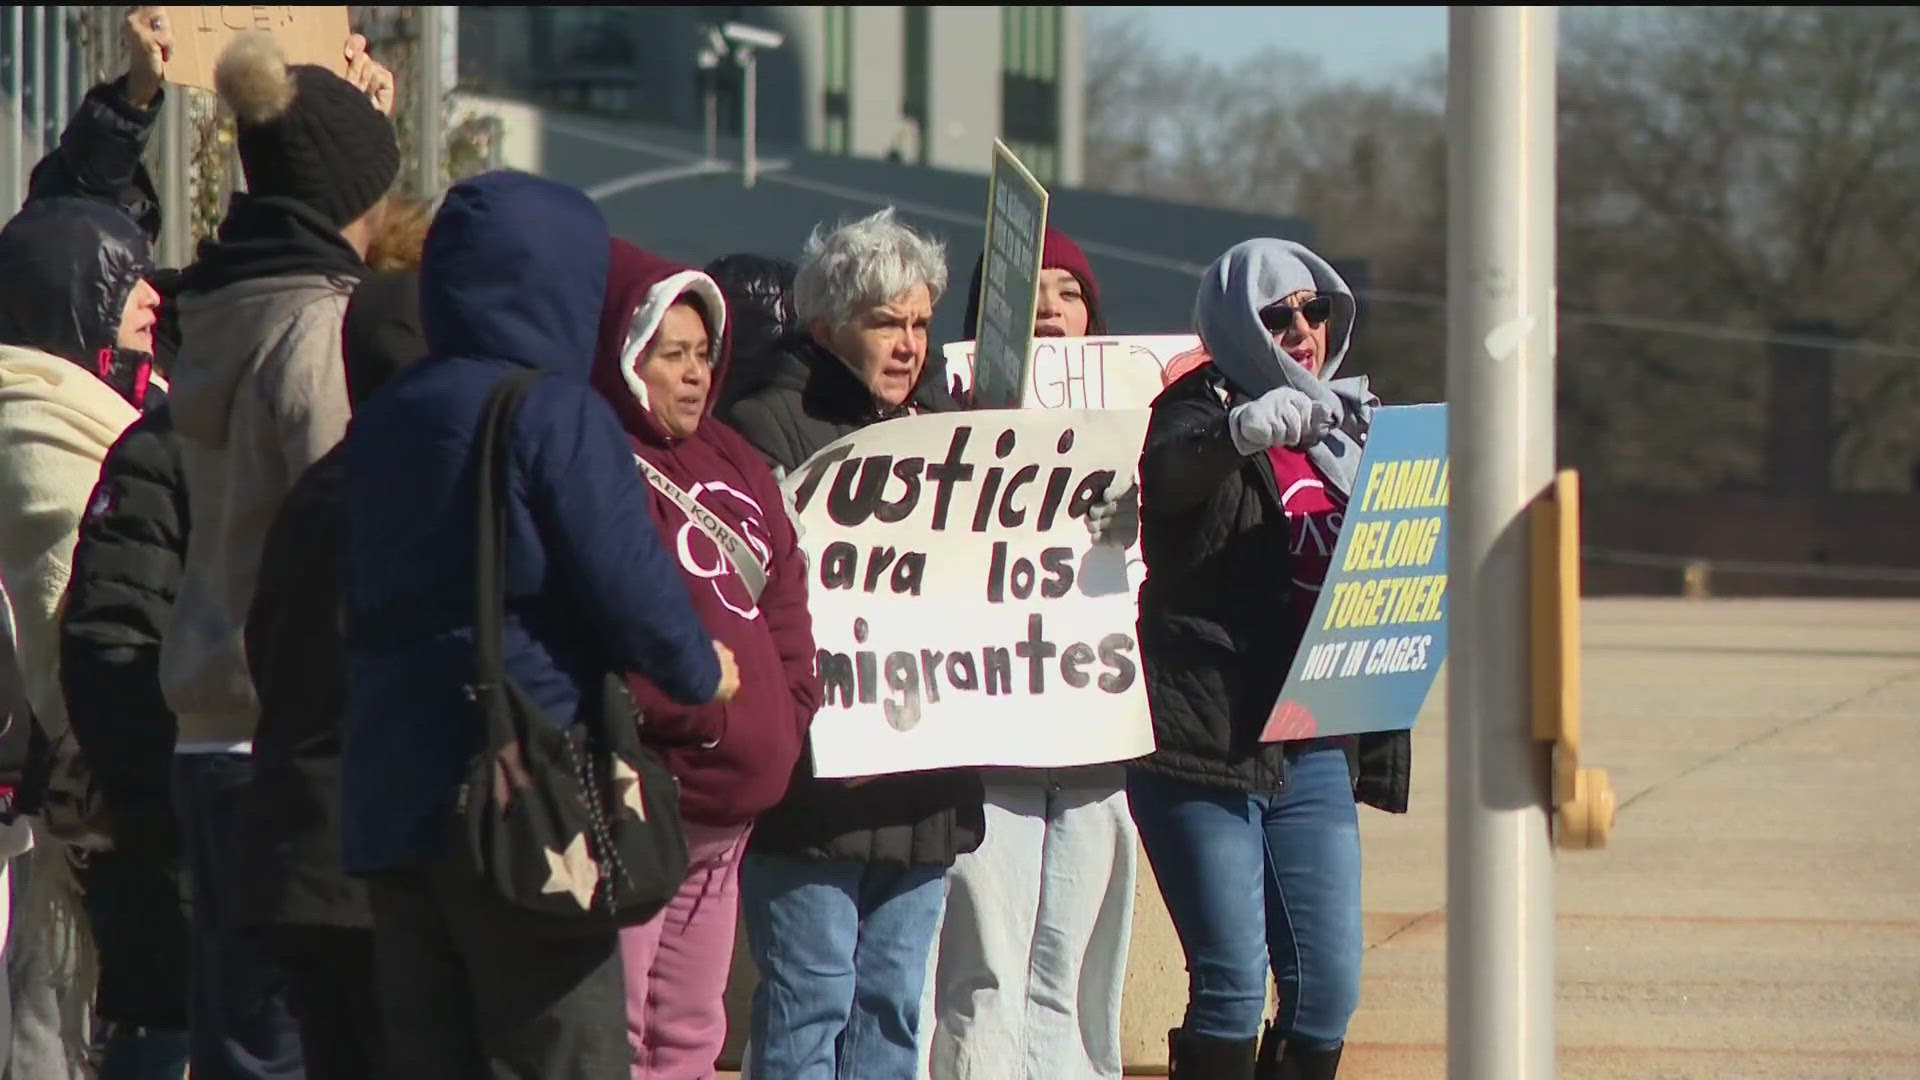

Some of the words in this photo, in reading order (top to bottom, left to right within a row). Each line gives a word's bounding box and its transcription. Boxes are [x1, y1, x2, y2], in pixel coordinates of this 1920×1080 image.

[691, 505, 738, 553] KORS
[1343, 516, 1441, 572] BELONG
[820, 541, 926, 596] ara
[987, 541, 1074, 603] los
[1322, 575, 1448, 631] TOGETHER.
[1300, 644, 1347, 682] NOT
[1339, 640, 1371, 678] IN
[1364, 635, 1432, 676] CAGES.
